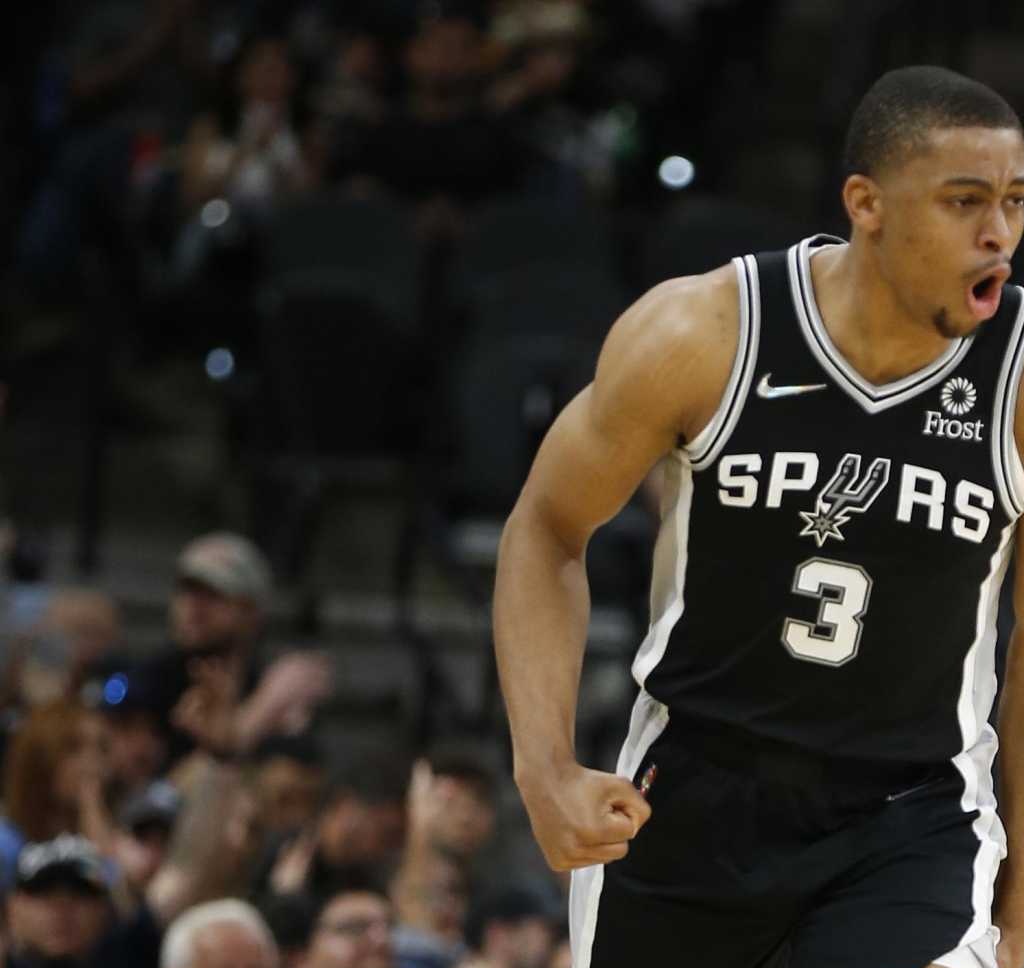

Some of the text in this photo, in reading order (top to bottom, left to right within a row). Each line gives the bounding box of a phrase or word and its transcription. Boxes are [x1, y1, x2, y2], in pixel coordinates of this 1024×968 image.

[923, 410, 984, 441] Frost
[717, 451, 995, 547] SPURS
[780, 556, 874, 667] 3
